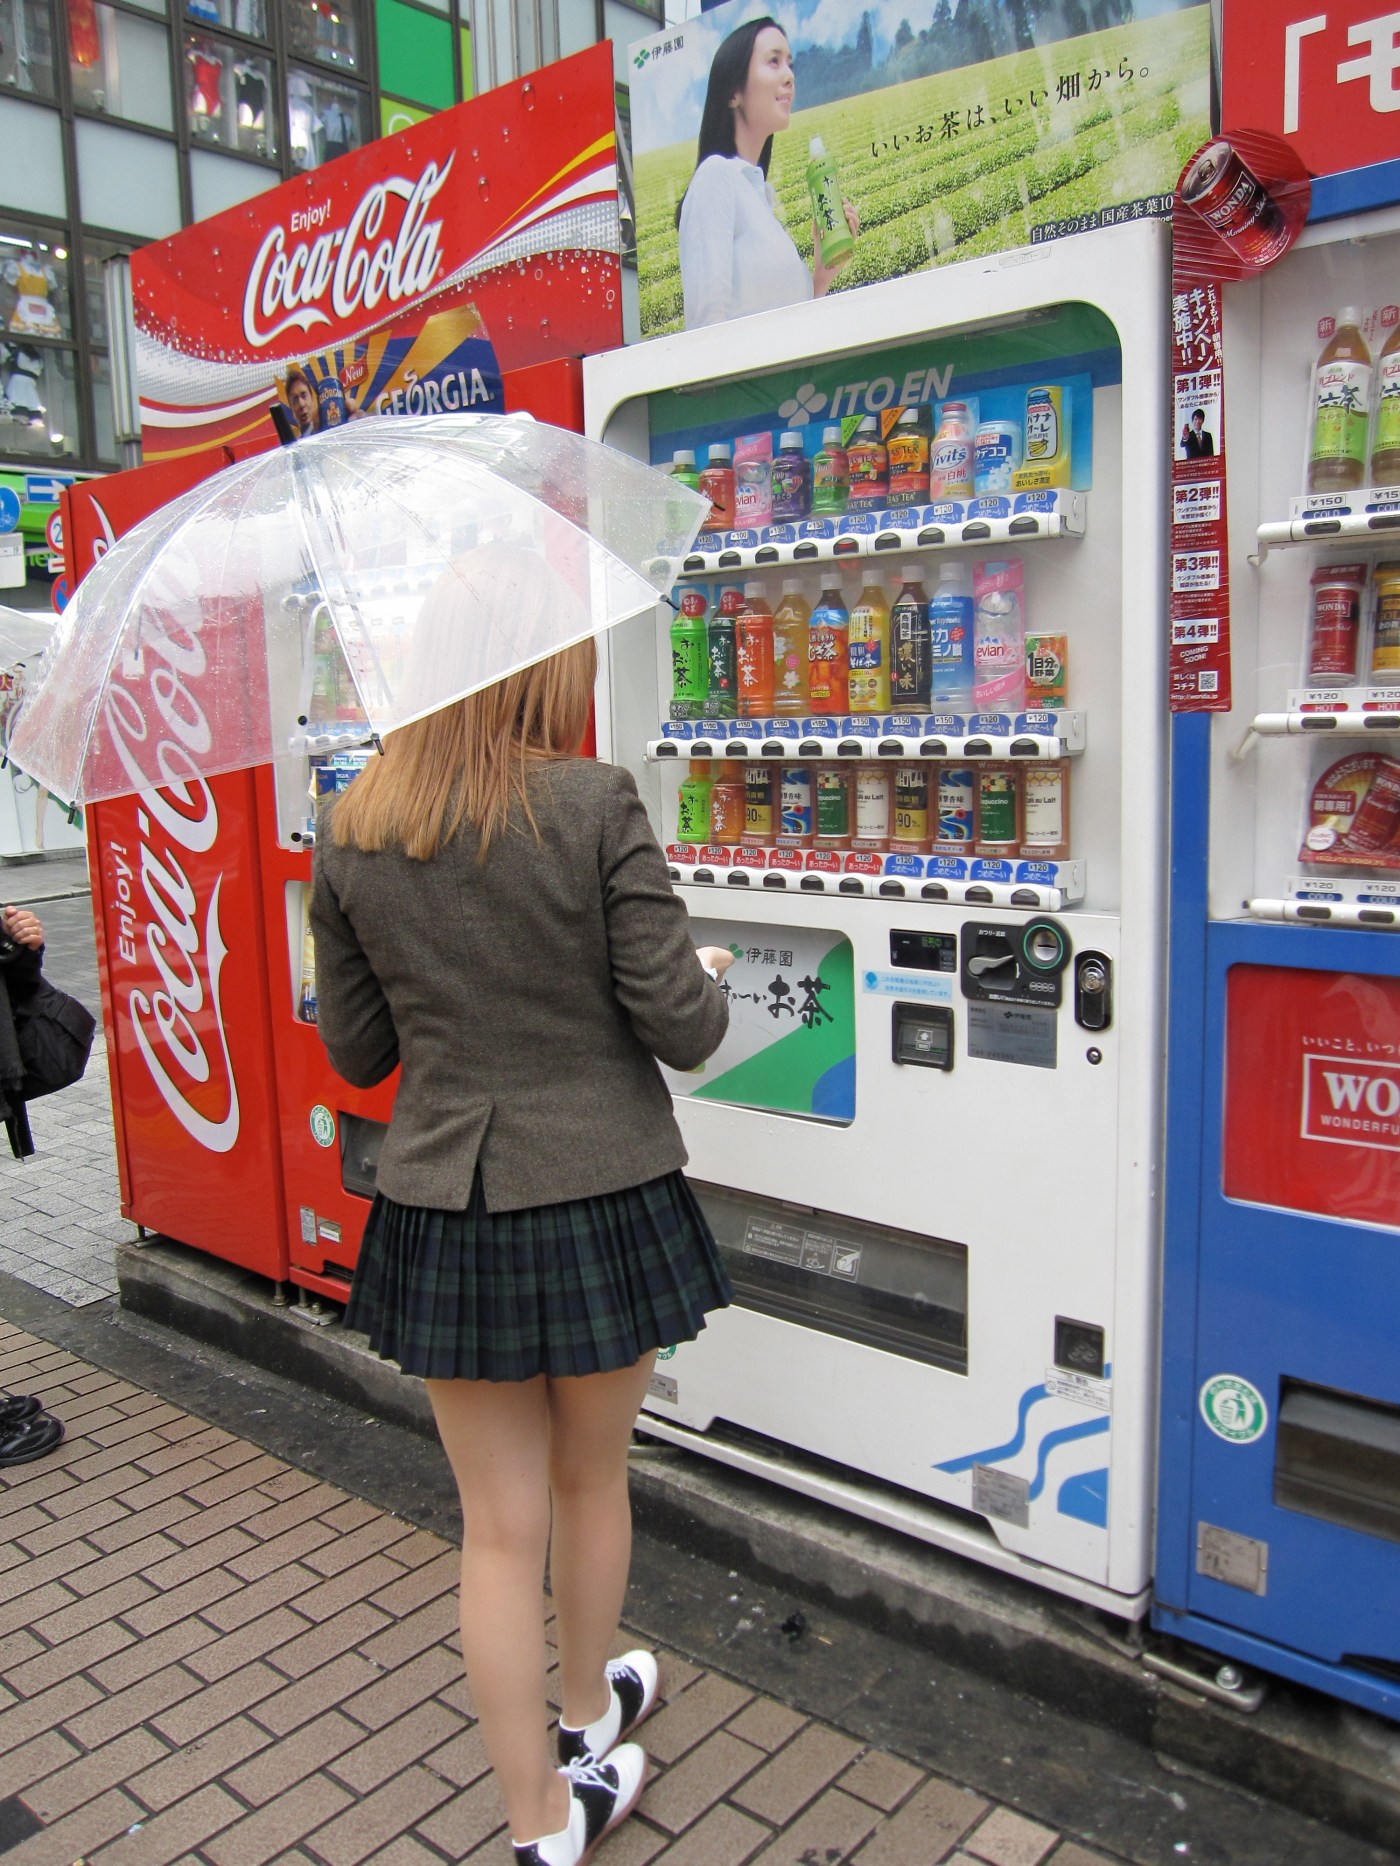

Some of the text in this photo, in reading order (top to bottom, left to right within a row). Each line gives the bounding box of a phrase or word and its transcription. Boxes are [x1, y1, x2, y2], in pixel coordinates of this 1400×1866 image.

[651, 35, 685, 60] 伊藤園
[871, 57, 1150, 158] いいお茶は、いい畑から。
[1209, 180, 1251, 221] WONDA
[290, 198, 331, 233] Enjoy!
[1032, 212, 1098, 243] 自然そのまま
[243, 148, 457, 347] Coca-Cola
[1381, 307, 1396, 320] 新
[1189, 288, 1213, 372] キャンペーン
[1318, 319, 1333, 332] 新
[342, 365, 364, 388] New
[1176, 373, 1221, 394] 第1弾!!
[375, 367, 490, 415] GEORGIA
[829, 364, 954, 419] ITO EN
[1318, 385, 1362, 414] 六茶
[947, 469, 967, 481] 白桃
[1028, 493, 1046, 501] ¥120
[1175, 486, 1219, 504] 第2弾!!
[1311, 497, 1343, 506] ¥150
[935, 505, 952, 513] ¥120
[980, 499, 998, 507] ¥120
[1175, 555, 1219, 573] 第3弾!!
[1316, 603, 1346, 612] WONDA
[1174, 624, 1217, 639] 第4弾!!
[932, 643, 963, 657] ミノ酸
[976, 645, 1004, 658] evian
[1180, 645, 1209, 658] COMING
[898, 642, 915, 690] 濃い味
[1184, 653, 1207, 664] SOON!
[1309, 692, 1338, 700] ¥120
[1315, 704, 1335, 712] HOT
[1378, 703, 1398, 711] HOT
[1029, 714, 1047, 722] ¥120
[897, 813, 911, 828] 90
[896, 856, 913, 864] ¥120
[1305, 882, 1334, 890] ¥120
[110, 841, 136, 965] Enjoy!
[1308, 892, 1334, 901] COLD
[1370, 896, 1397, 904] COLD
[745, 947, 793, 968] 伊藤園
[1322, 1071, 1400, 1117] WO
[1320, 1114, 1400, 1136] WONDERFU
